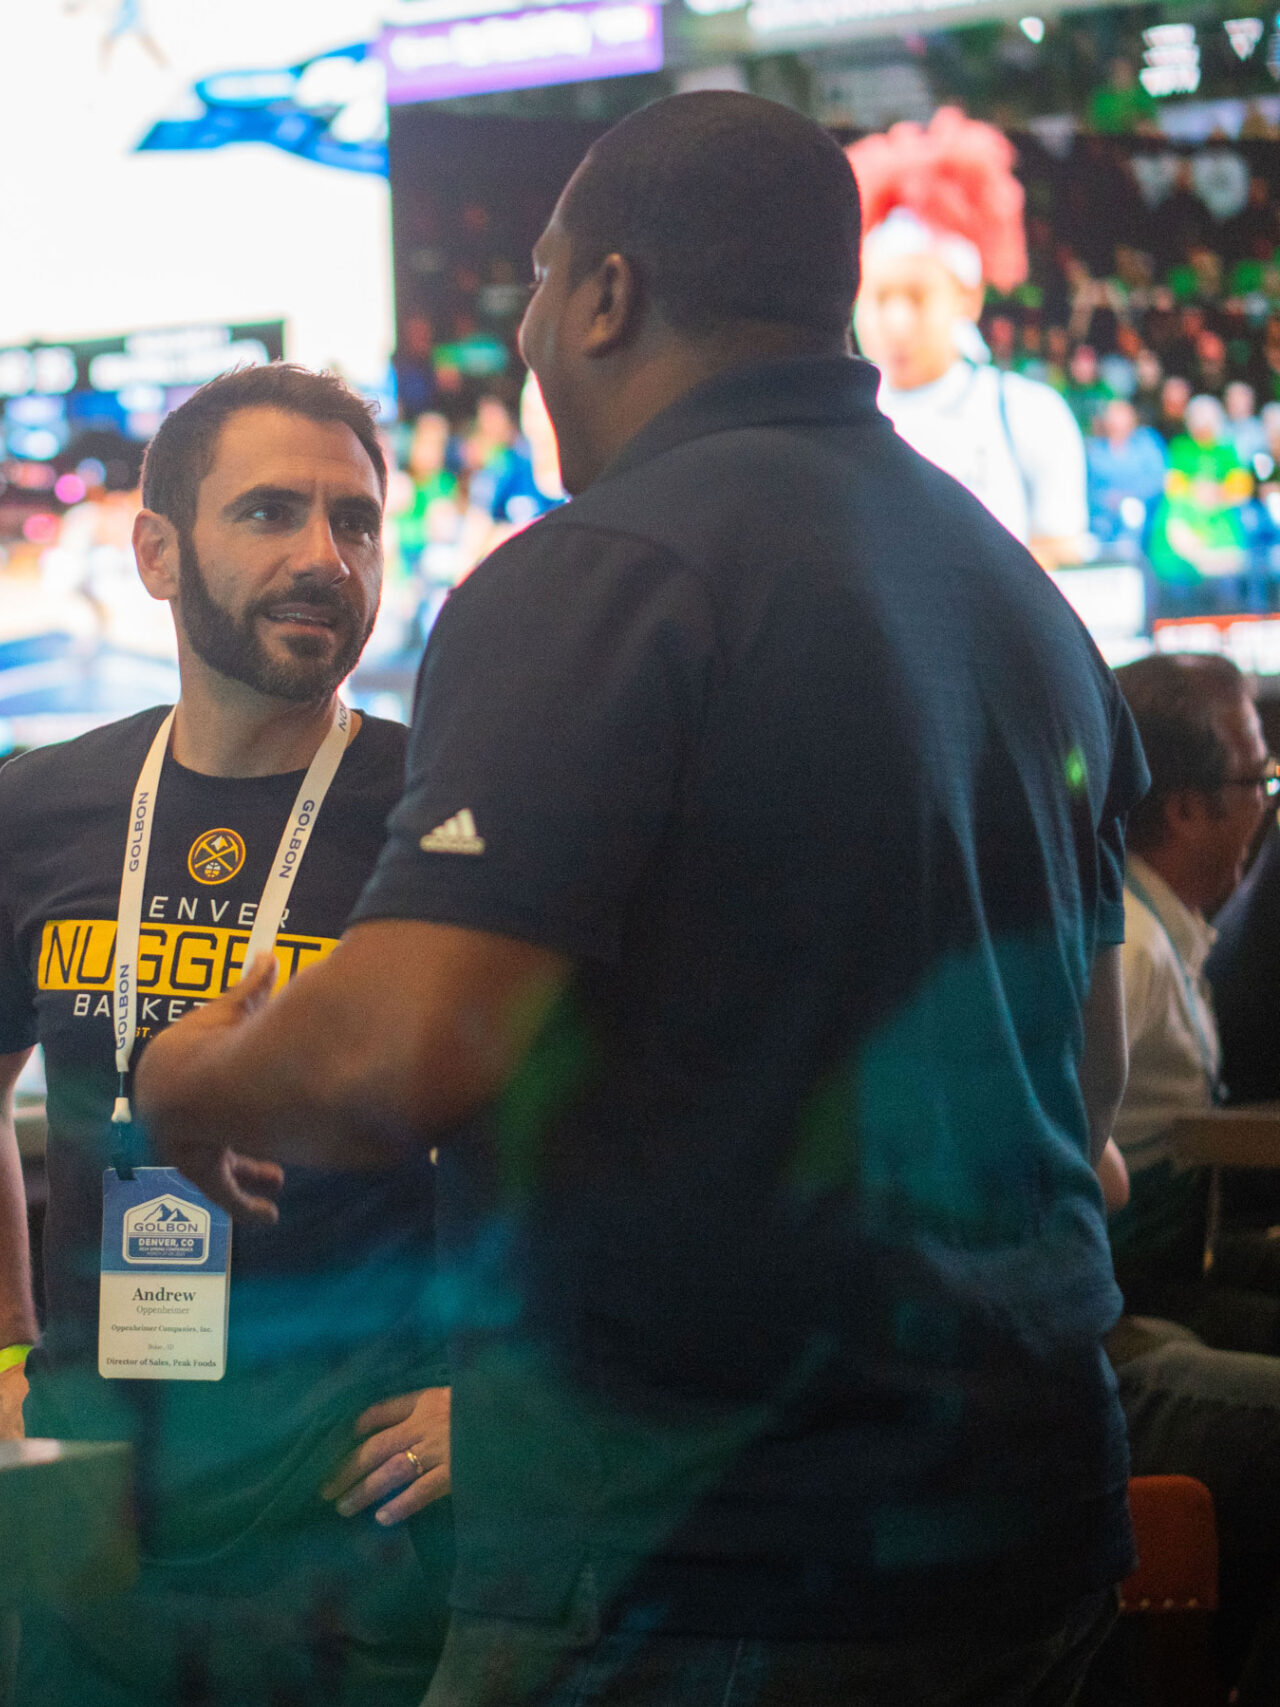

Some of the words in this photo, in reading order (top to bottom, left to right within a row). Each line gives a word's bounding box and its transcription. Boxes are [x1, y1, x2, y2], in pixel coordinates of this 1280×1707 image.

[128, 791, 150, 872] GOLBON
[278, 799, 316, 879] GOLBON
[148, 895, 290, 930] ENVER
[44, 925, 322, 993] NUGGET
[116, 963, 131, 1050] GOLBON
[133, 1222, 198, 1233] GOLBON
[138, 1238, 179, 1248] DENVER,
[180, 1238, 195, 1247] CO
[132, 1286, 197, 1302] Andrew
[136, 1305, 190, 1316] Oppenheimer
[106, 1357, 139, 1366] Director
[139, 1358, 149, 1366] of
[173, 1359, 191, 1367] Peak
[193, 1359, 217, 1368] Foods
